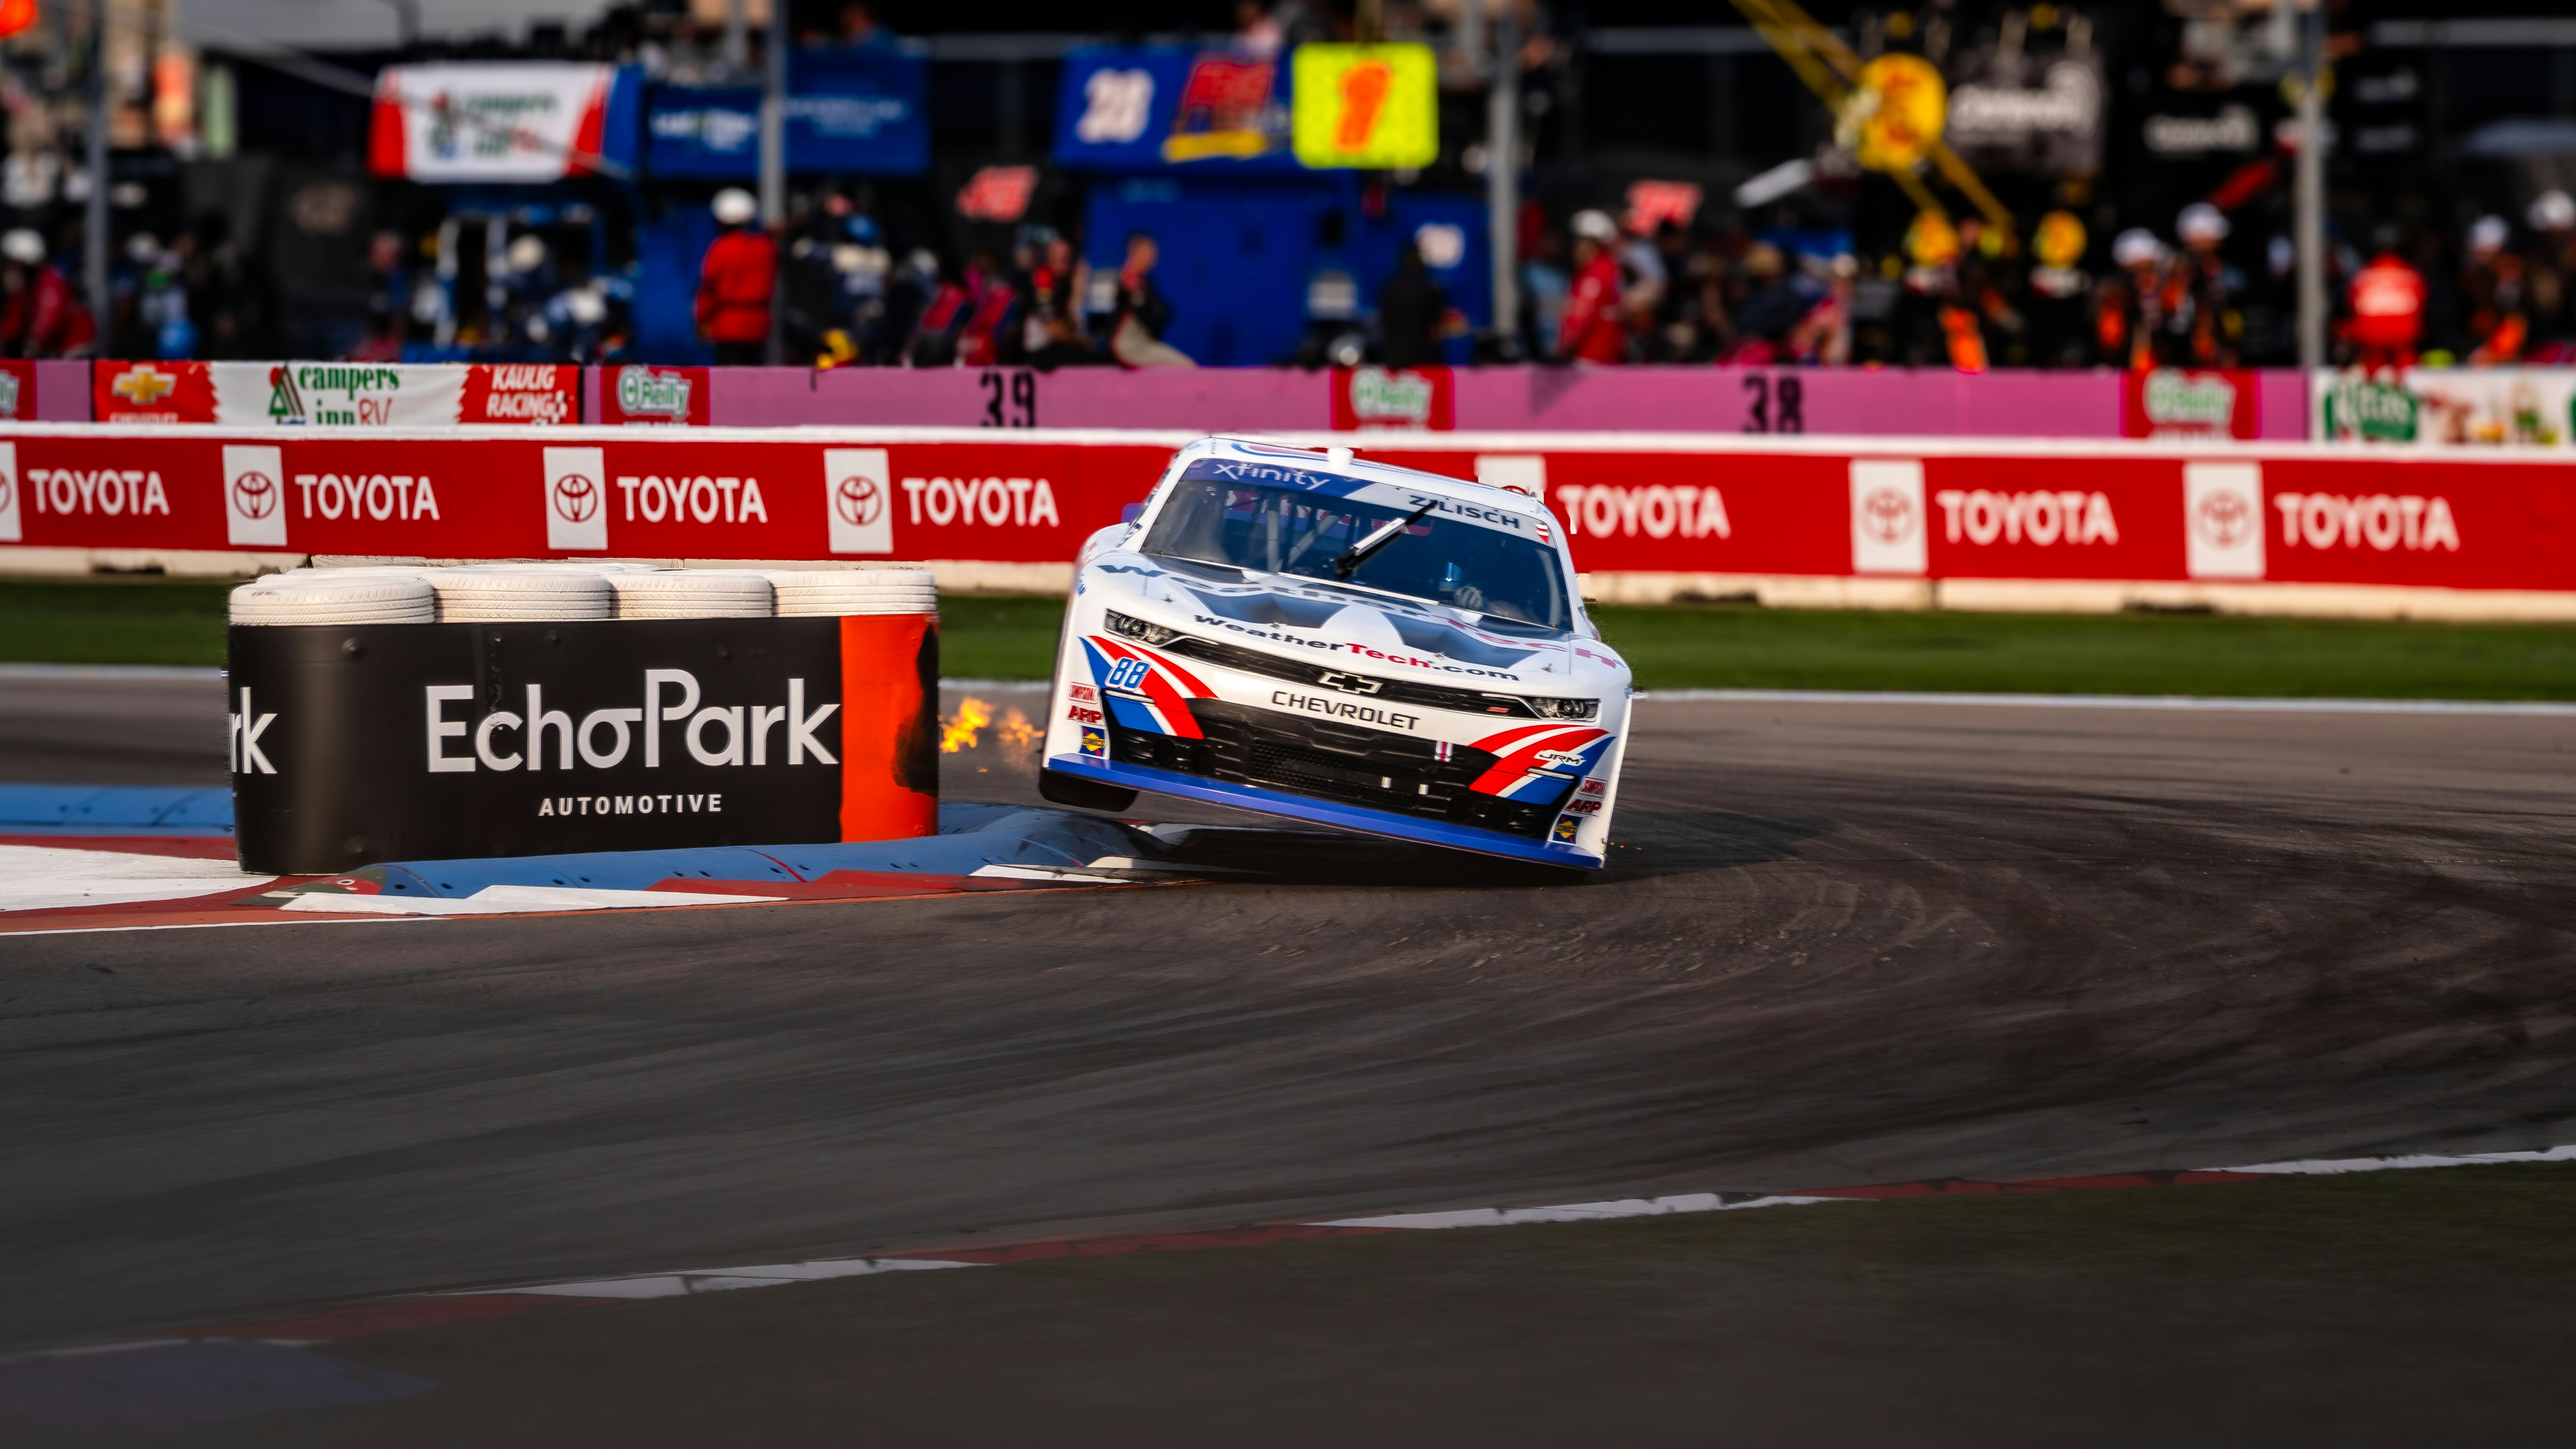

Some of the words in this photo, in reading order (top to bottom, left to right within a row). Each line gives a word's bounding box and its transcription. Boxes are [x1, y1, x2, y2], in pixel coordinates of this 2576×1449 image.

[299, 366, 400, 401] campers
[491, 365, 557, 390] KAULIG
[980, 372, 1035, 427] 39
[316, 398, 355, 425] inn
[359, 397, 392, 425] RV
[486, 393, 554, 417] RACING
[1742, 375, 1802, 433] 38
[27, 468, 170, 515] TOYOTA
[295, 473, 440, 521] TOYOTA
[616, 475, 768, 524] TOYOTA
[1214, 463, 1331, 490] xfinity
[901, 477, 1059, 527] TOYOTA
[1556, 483, 1731, 539] TOYOTA
[1935, 489, 2119, 546] TOYOTA
[2274, 492, 2460, 551] TOYOTA
[1108, 657, 1150, 689] 88
[426, 669, 841, 773] EchoPark
[1271, 691, 1421, 730] CHEVROLET
[1539, 754, 1580, 764] JRM
[538, 793, 722, 817] AUTOMOTIVE
